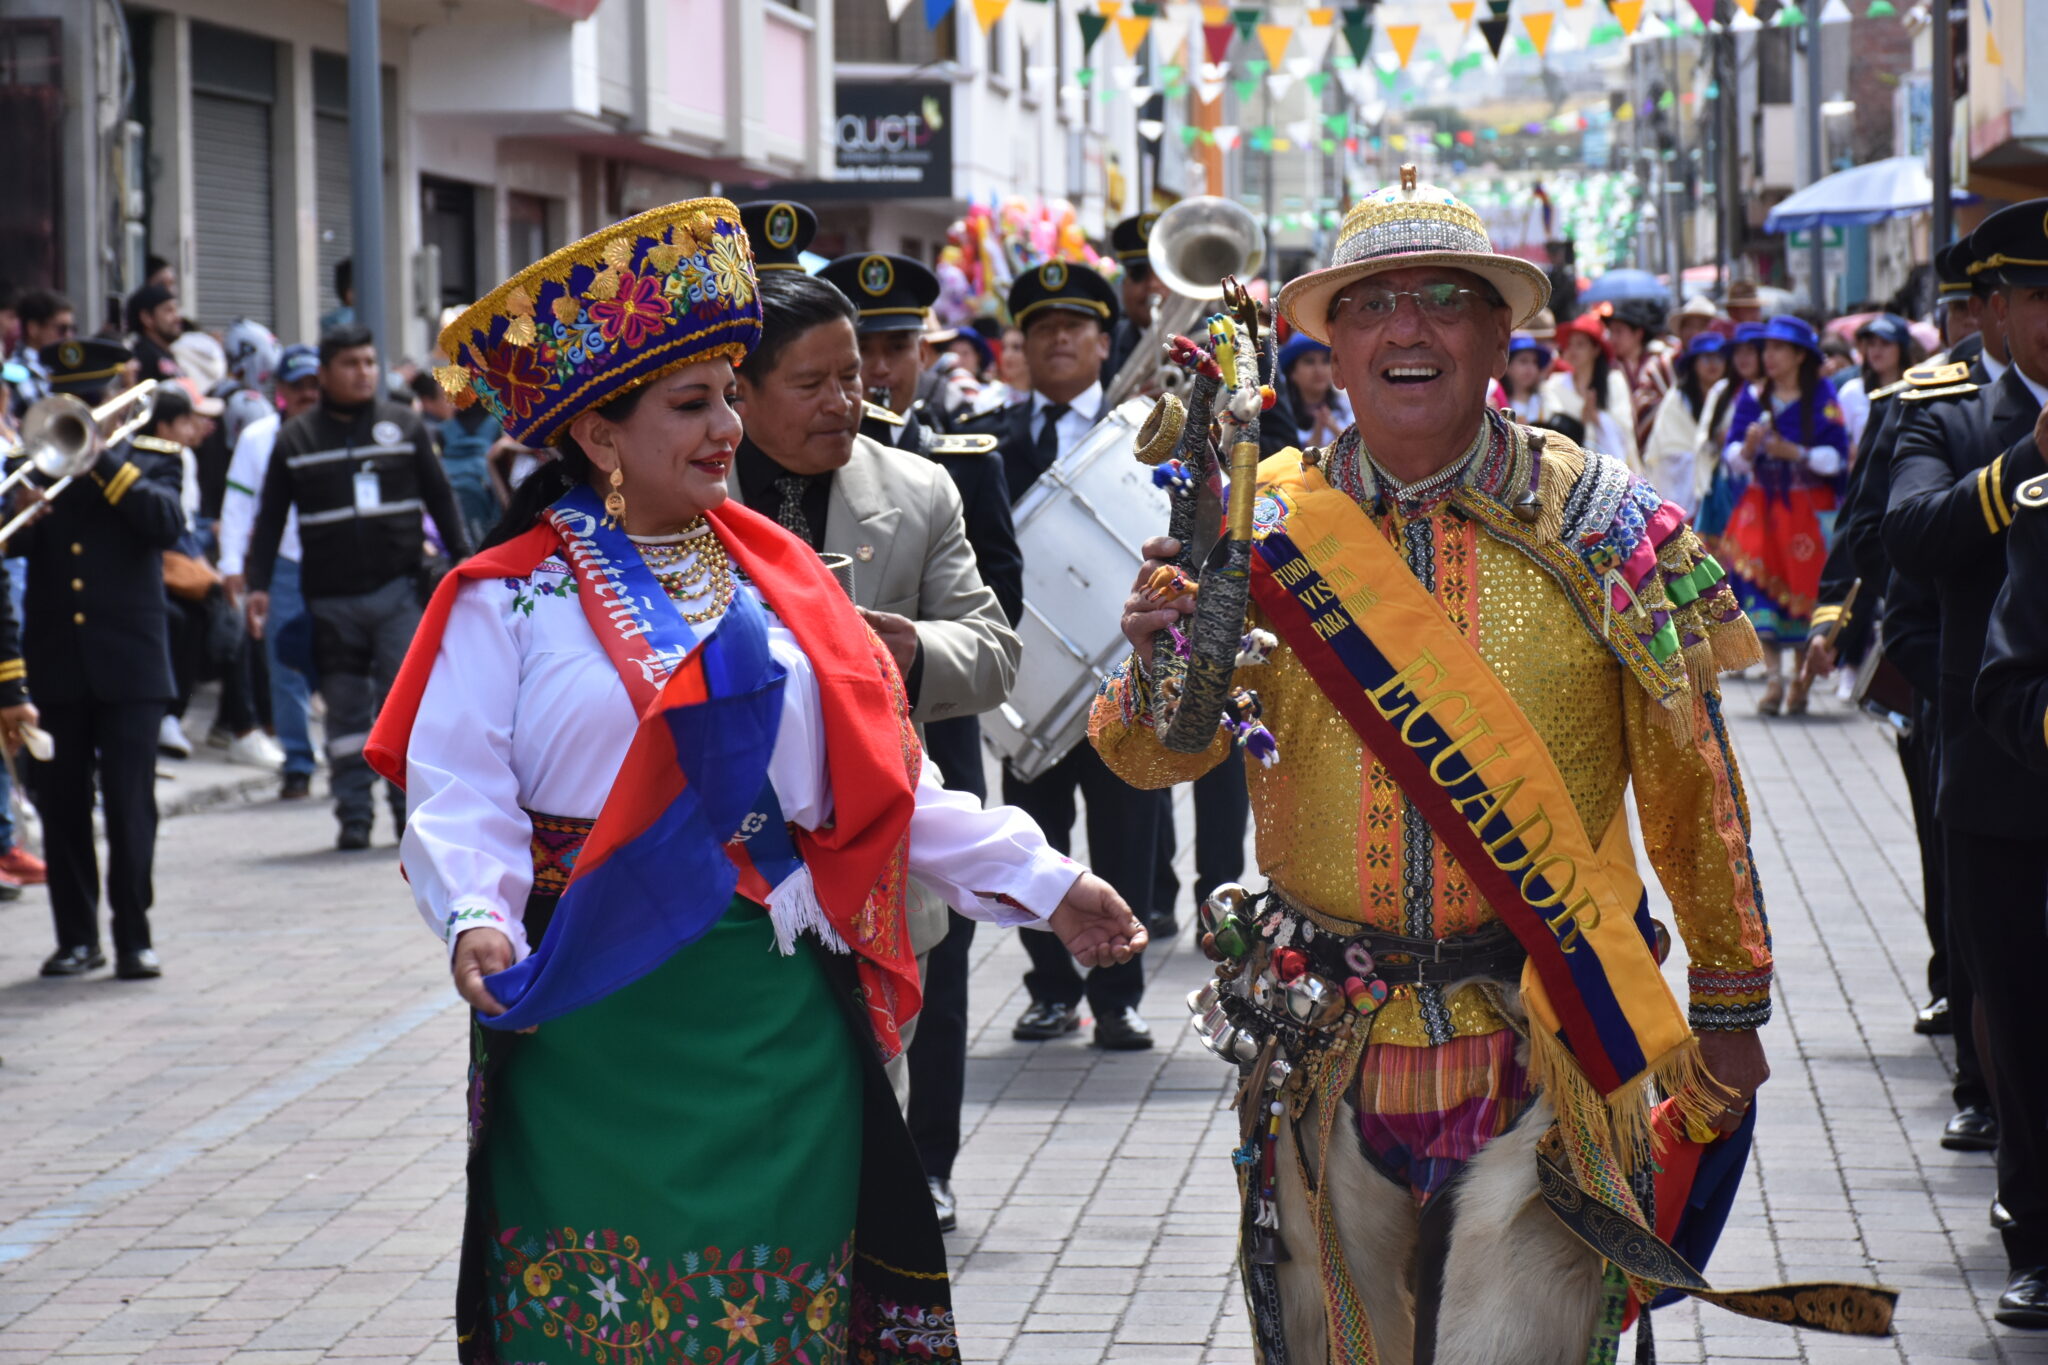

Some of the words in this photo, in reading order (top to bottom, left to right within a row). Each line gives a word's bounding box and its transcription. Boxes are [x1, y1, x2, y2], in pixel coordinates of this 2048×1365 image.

[549, 507, 654, 641] Quiteña
[1298, 564, 1357, 610] VISTA
[1310, 608, 1350, 641] PARA
[1364, 647, 1601, 954] ECUADOR
